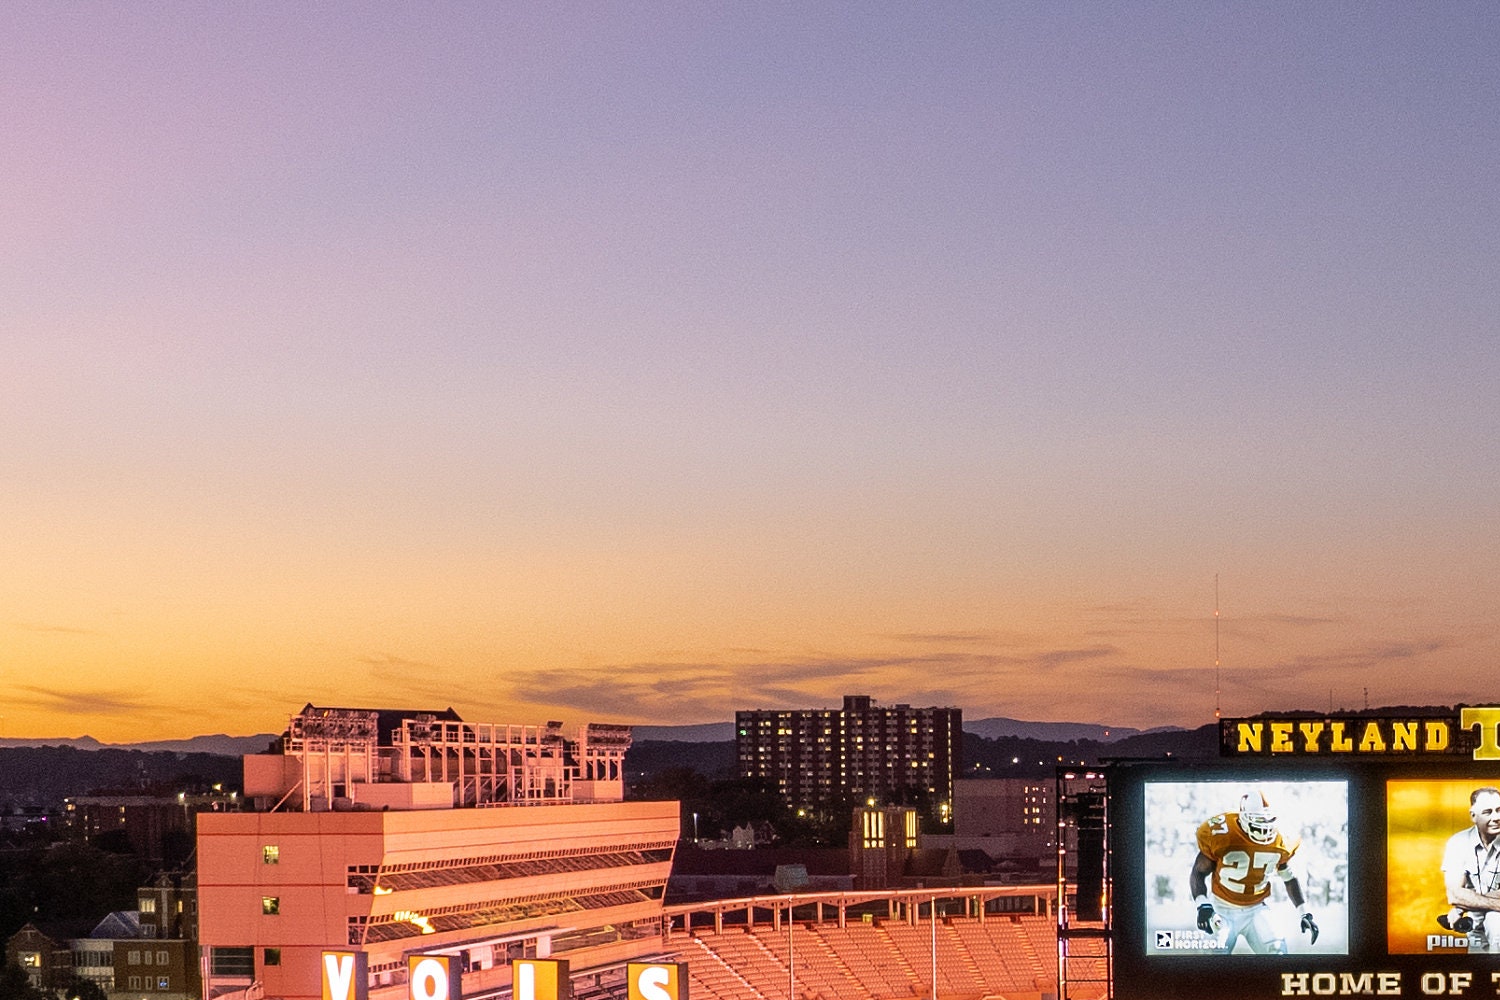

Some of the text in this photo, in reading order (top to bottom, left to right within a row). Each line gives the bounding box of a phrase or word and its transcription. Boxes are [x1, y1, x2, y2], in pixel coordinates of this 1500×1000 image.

[1237, 722, 1450, 752] NEYLAND
[1219, 850, 1282, 896] 27
[1174, 931, 1206, 940] FIRST
[1426, 934, 1482, 951] Pilot
[1281, 972, 1401, 996] HOME
[1421, 972, 1473, 996] OF
